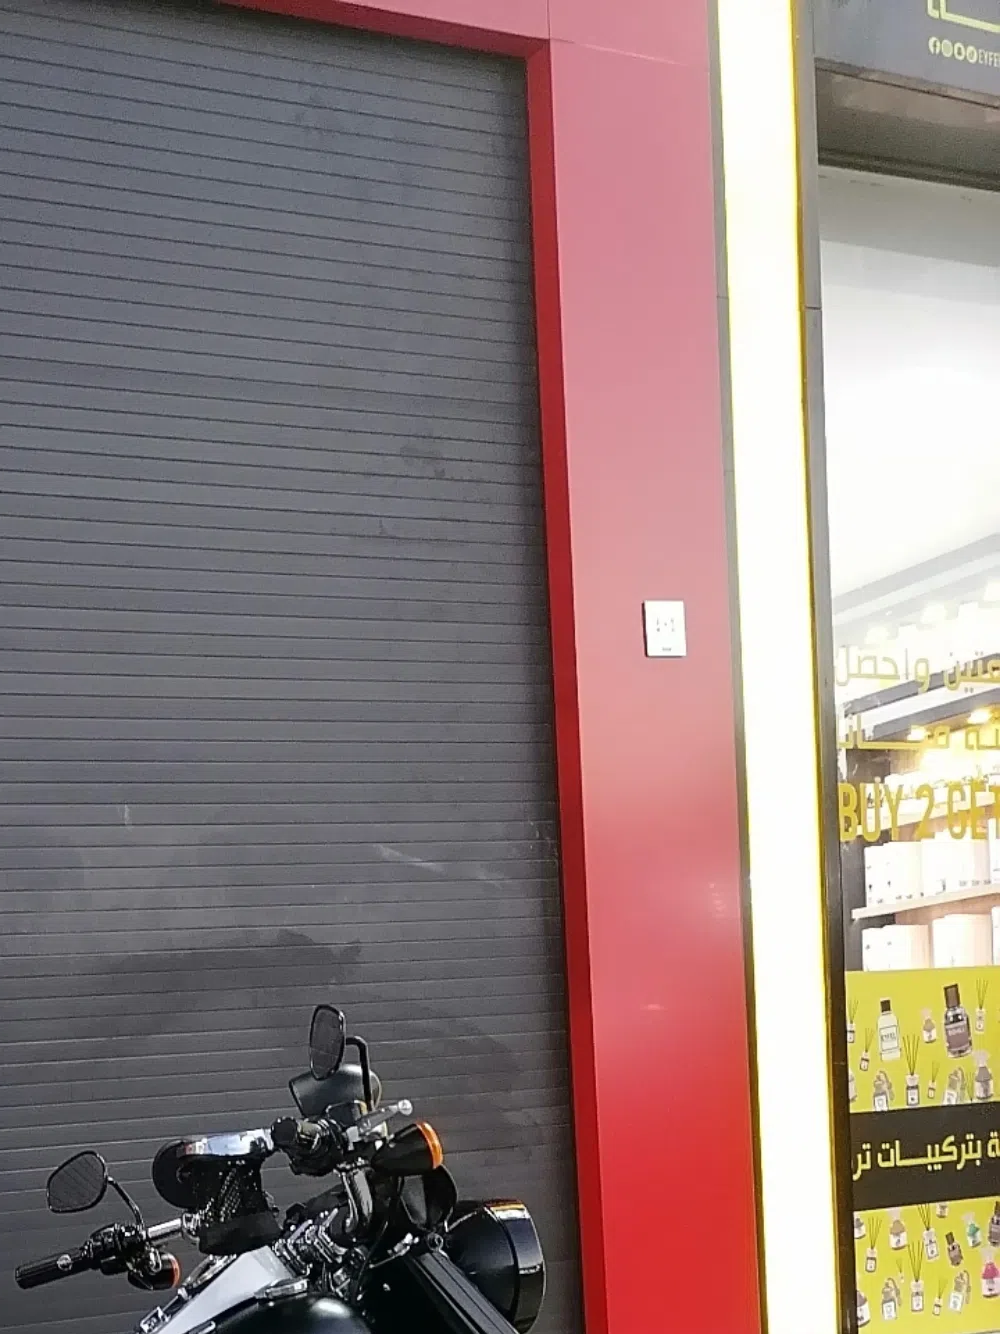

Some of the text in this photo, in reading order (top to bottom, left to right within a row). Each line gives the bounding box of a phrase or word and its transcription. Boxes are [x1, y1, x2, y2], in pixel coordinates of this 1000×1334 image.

[838, 782, 904, 842] BUY
[914, 784, 935, 839] 2
[877, 1133, 982, 1171] بتركيبات
